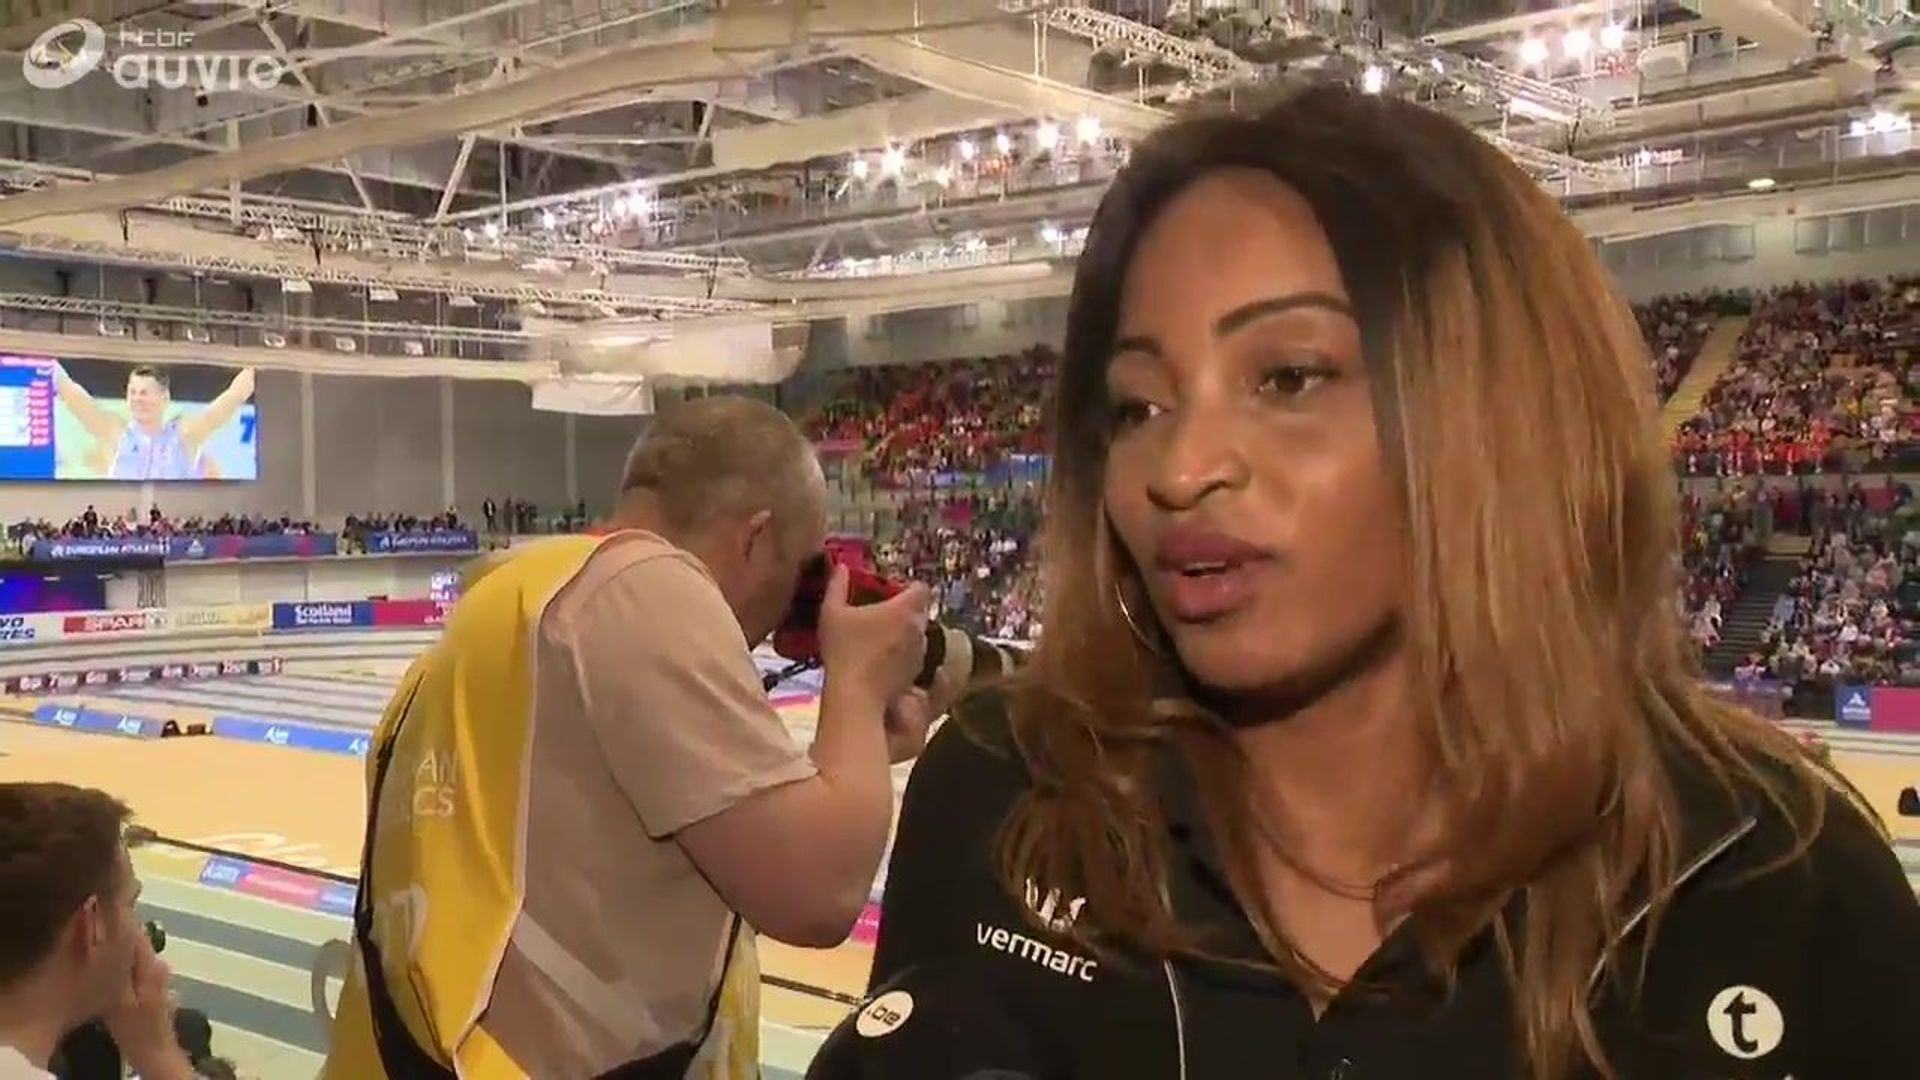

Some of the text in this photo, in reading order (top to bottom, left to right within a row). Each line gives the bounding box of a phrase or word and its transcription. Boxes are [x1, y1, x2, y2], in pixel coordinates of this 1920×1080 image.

[295, 603, 352, 618] Scotland
[975, 921, 1099, 983] vermarc
[1722, 990, 1759, 1054] t
